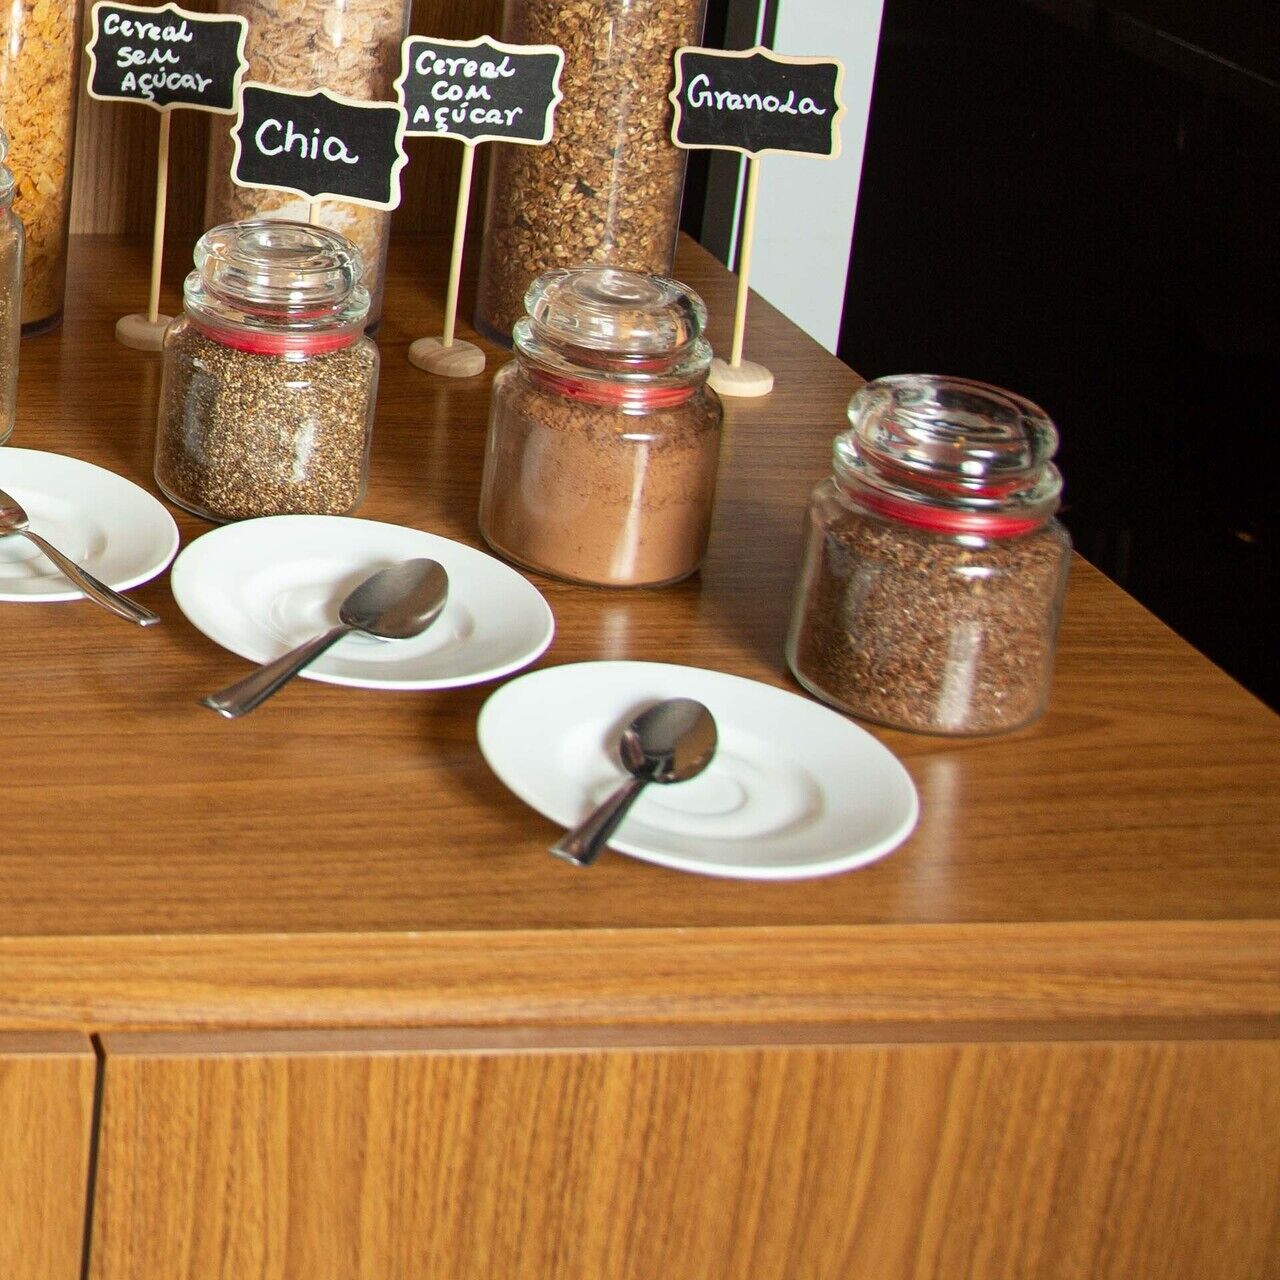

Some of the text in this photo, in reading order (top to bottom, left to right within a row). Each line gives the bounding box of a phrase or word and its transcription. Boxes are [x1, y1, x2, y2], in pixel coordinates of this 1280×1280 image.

[104, 13, 193, 42] Cereal
[415, 50, 516, 79] Cereal
[121, 66, 212, 100] Açúcar
[413, 102, 523, 133] Açúcar
[255, 119, 359, 164] Chia
